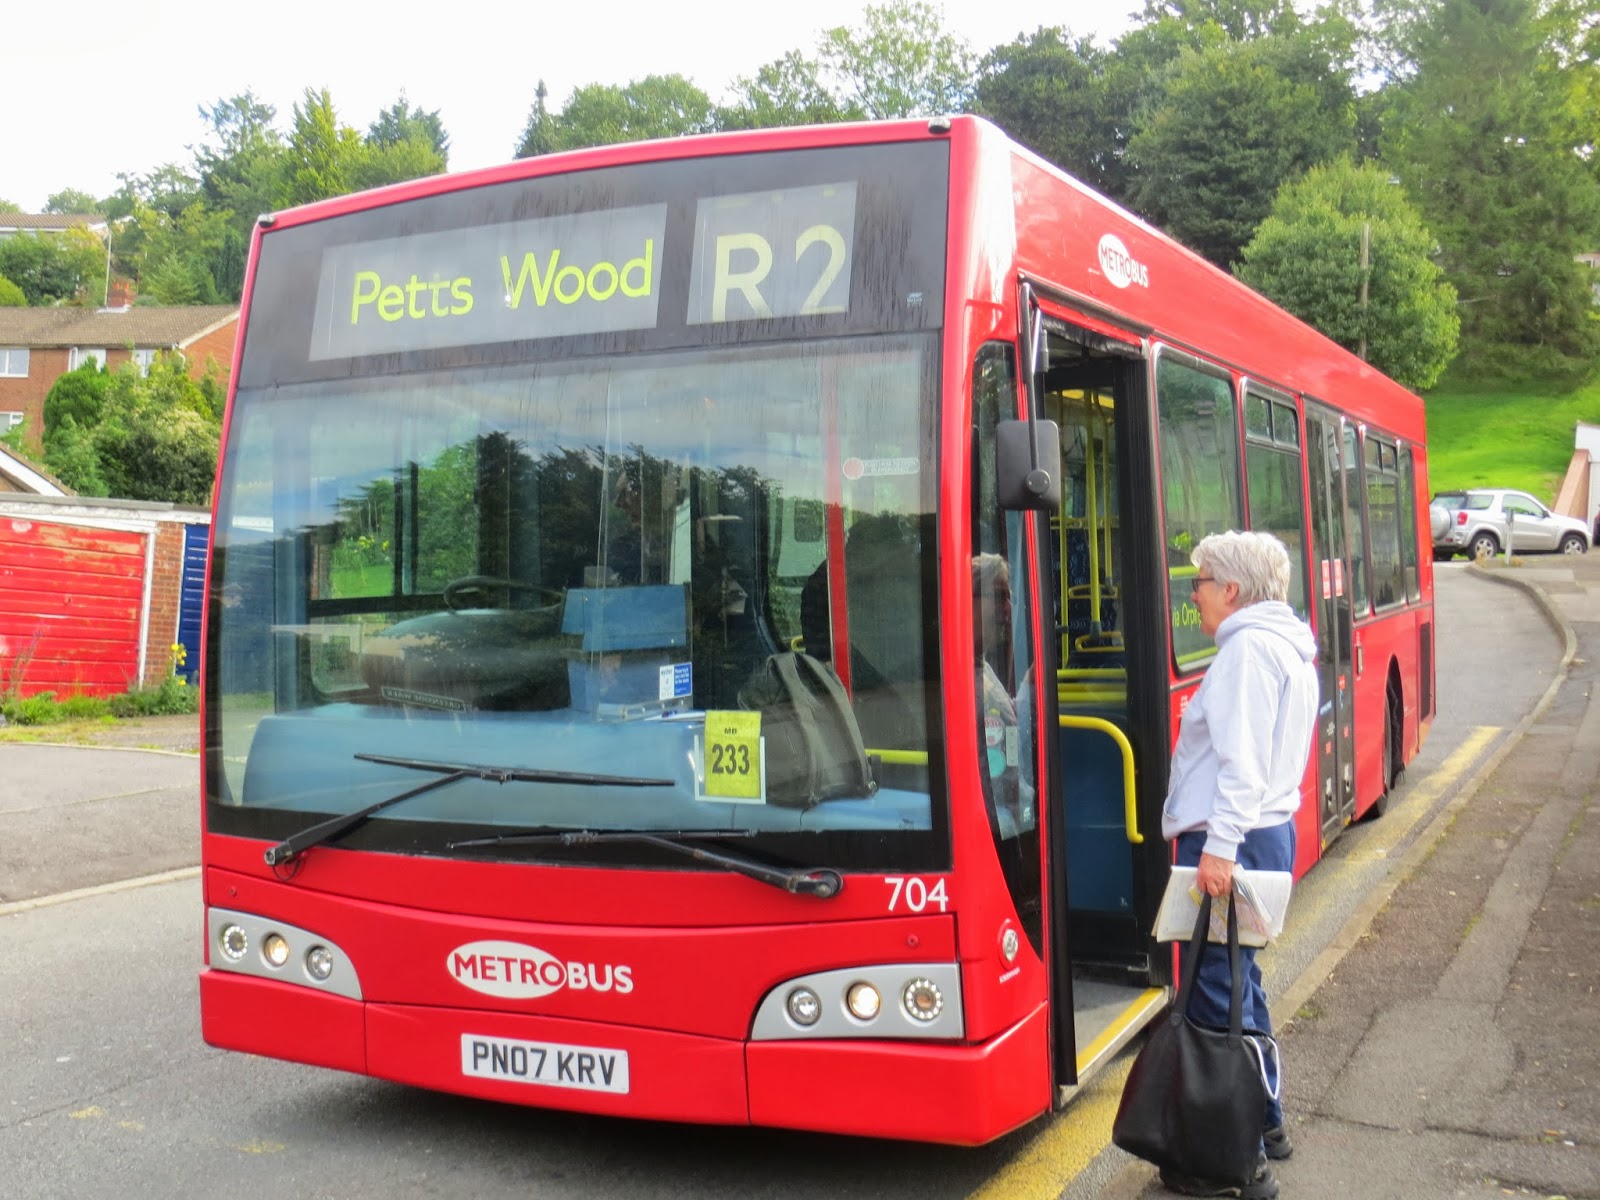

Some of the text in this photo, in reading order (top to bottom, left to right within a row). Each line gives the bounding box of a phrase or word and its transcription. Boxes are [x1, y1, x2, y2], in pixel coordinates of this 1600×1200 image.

[350, 238, 653, 325] Petts Wood
[1100, 242, 1149, 288] METROBUS
[711, 743, 750, 775] 233
[884, 876, 949, 913] 704
[453, 952, 634, 994] METROBUS
[472, 1040, 616, 1086] PN07 KRV
